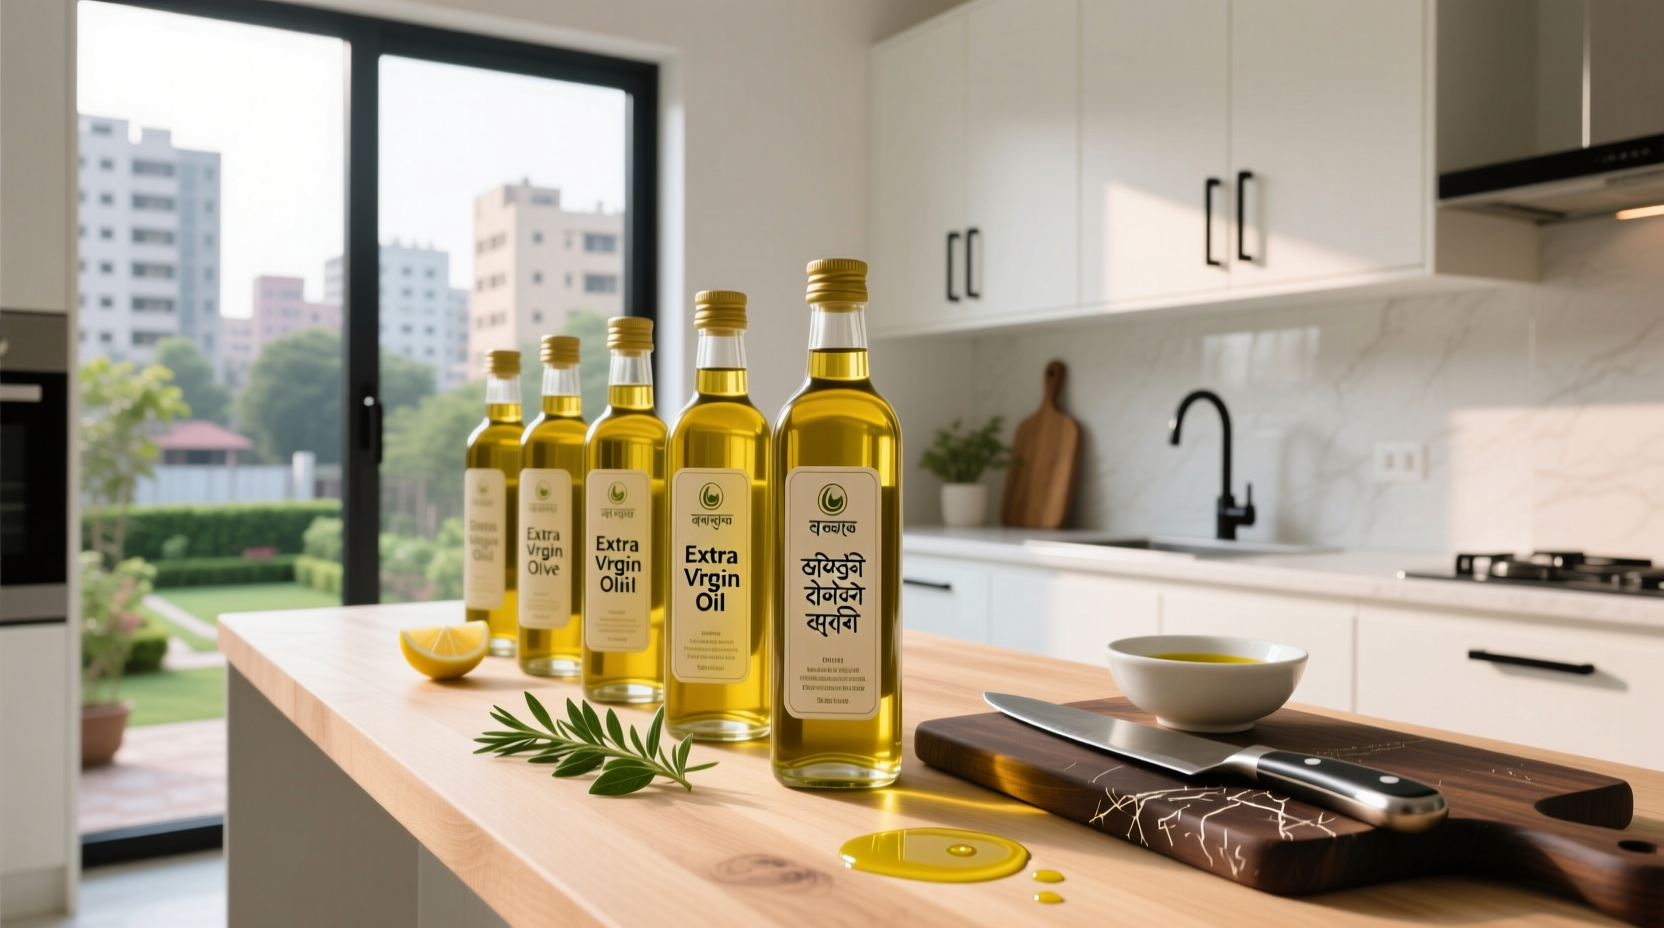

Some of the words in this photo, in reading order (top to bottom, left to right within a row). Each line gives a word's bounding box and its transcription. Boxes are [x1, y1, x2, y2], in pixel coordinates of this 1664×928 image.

[527, 527, 560, 541] Extra
[596, 535, 639, 552] Extra
[685, 545, 738, 564] Extra
[683, 568, 740, 593] Vrgin
[695, 592, 725, 612] Oil
